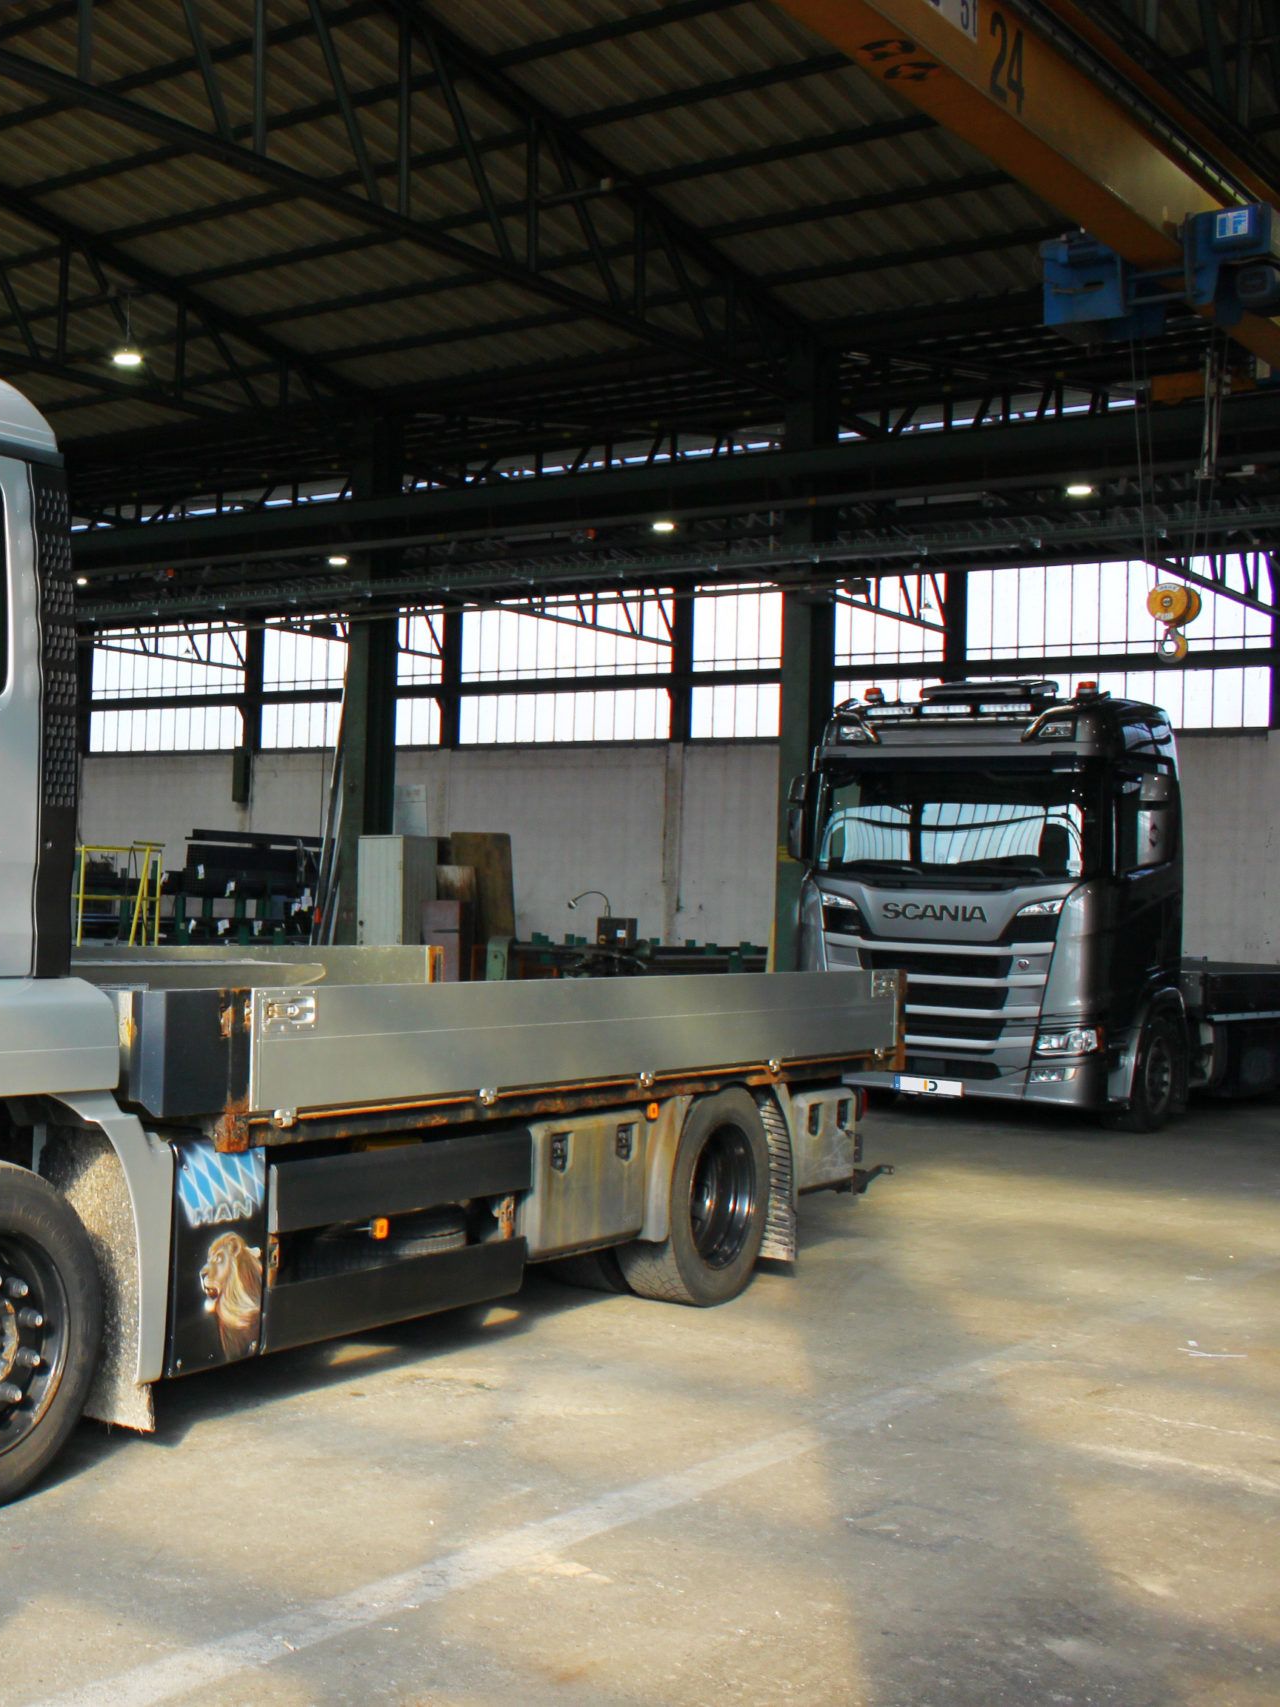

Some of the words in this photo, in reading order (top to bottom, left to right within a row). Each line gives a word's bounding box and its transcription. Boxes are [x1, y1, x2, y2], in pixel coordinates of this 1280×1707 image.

[990, 11, 1025, 114] 24
[882, 902, 987, 923] SCANIA
[193, 1200, 253, 1226] MAN
